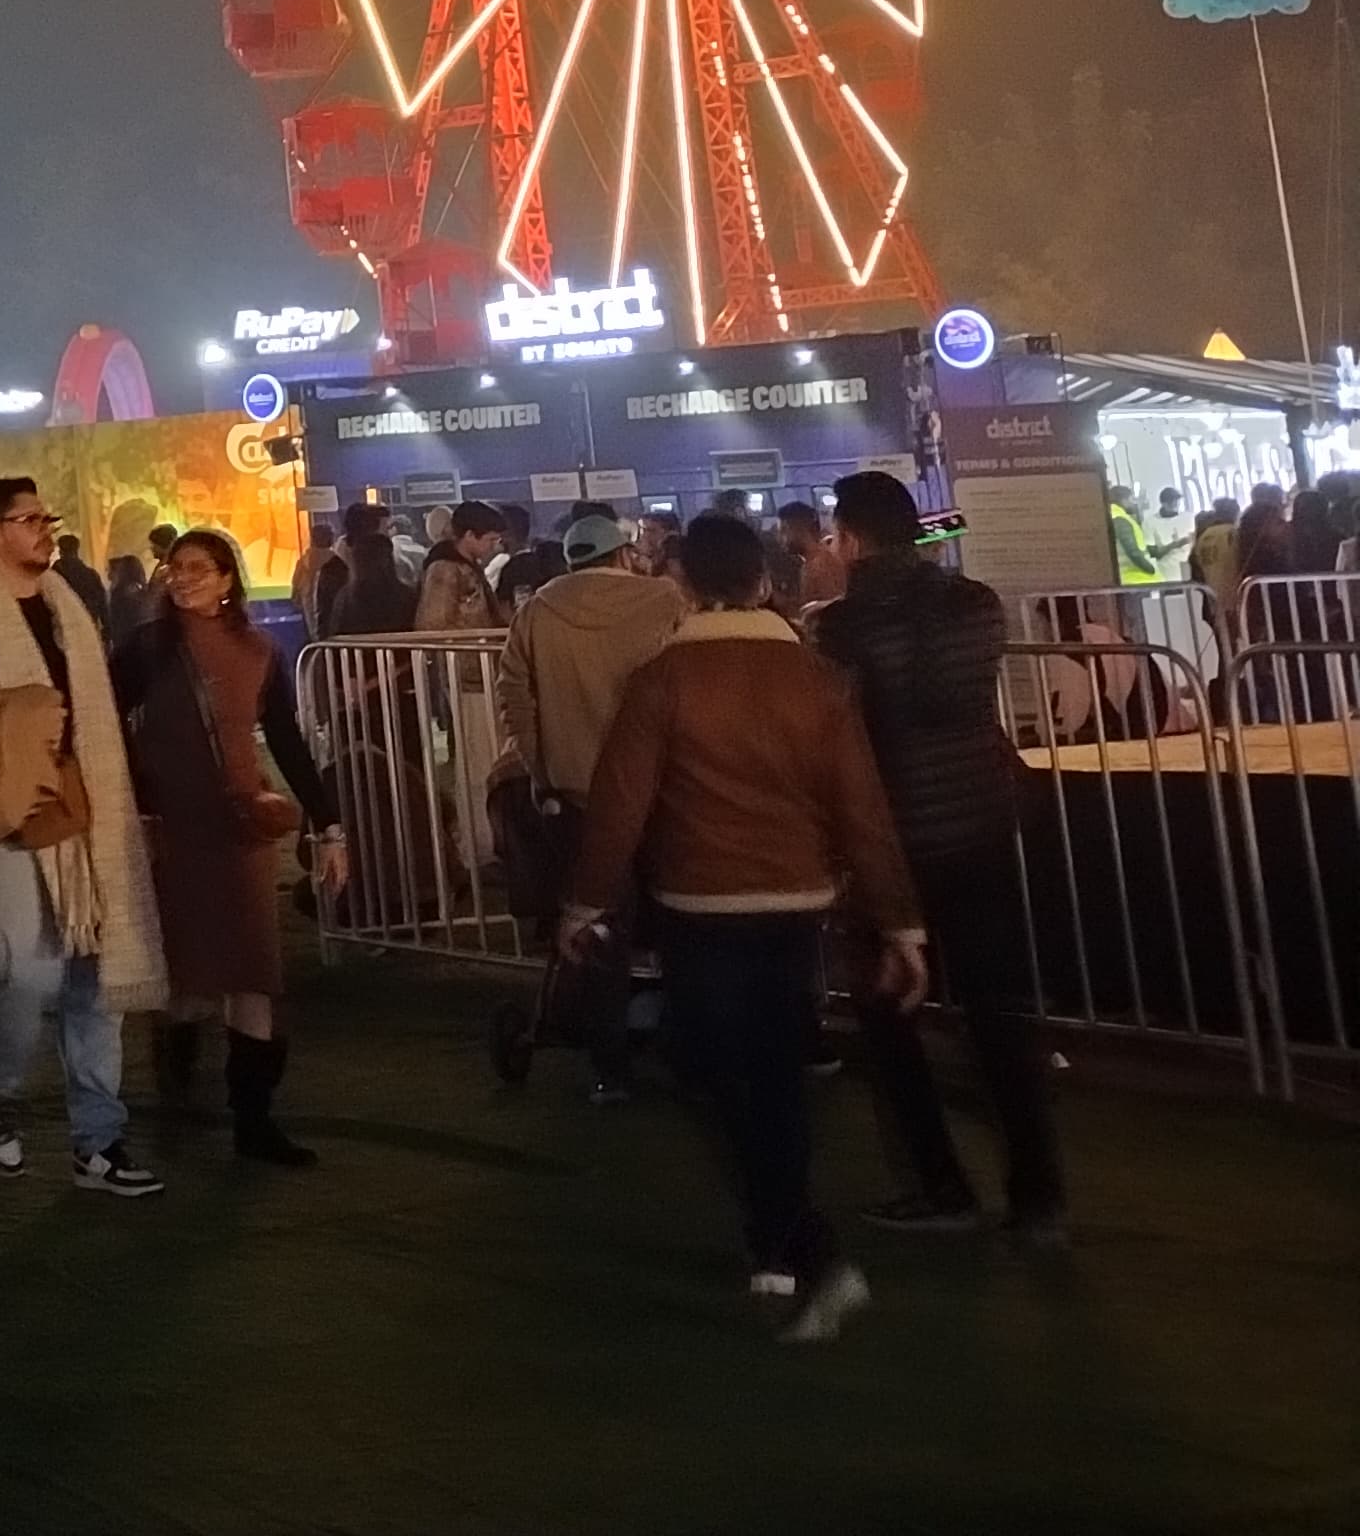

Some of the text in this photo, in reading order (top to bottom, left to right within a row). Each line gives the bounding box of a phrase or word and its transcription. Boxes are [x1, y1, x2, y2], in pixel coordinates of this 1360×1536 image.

[233, 306, 344, 341] RuPay
[255, 335, 320, 355] CREDIT
[626, 377, 868, 420] RECHARGE COUNTER
[337, 402, 541, 440] RECHARGE COUNTER
[986, 416, 1054, 439] district
